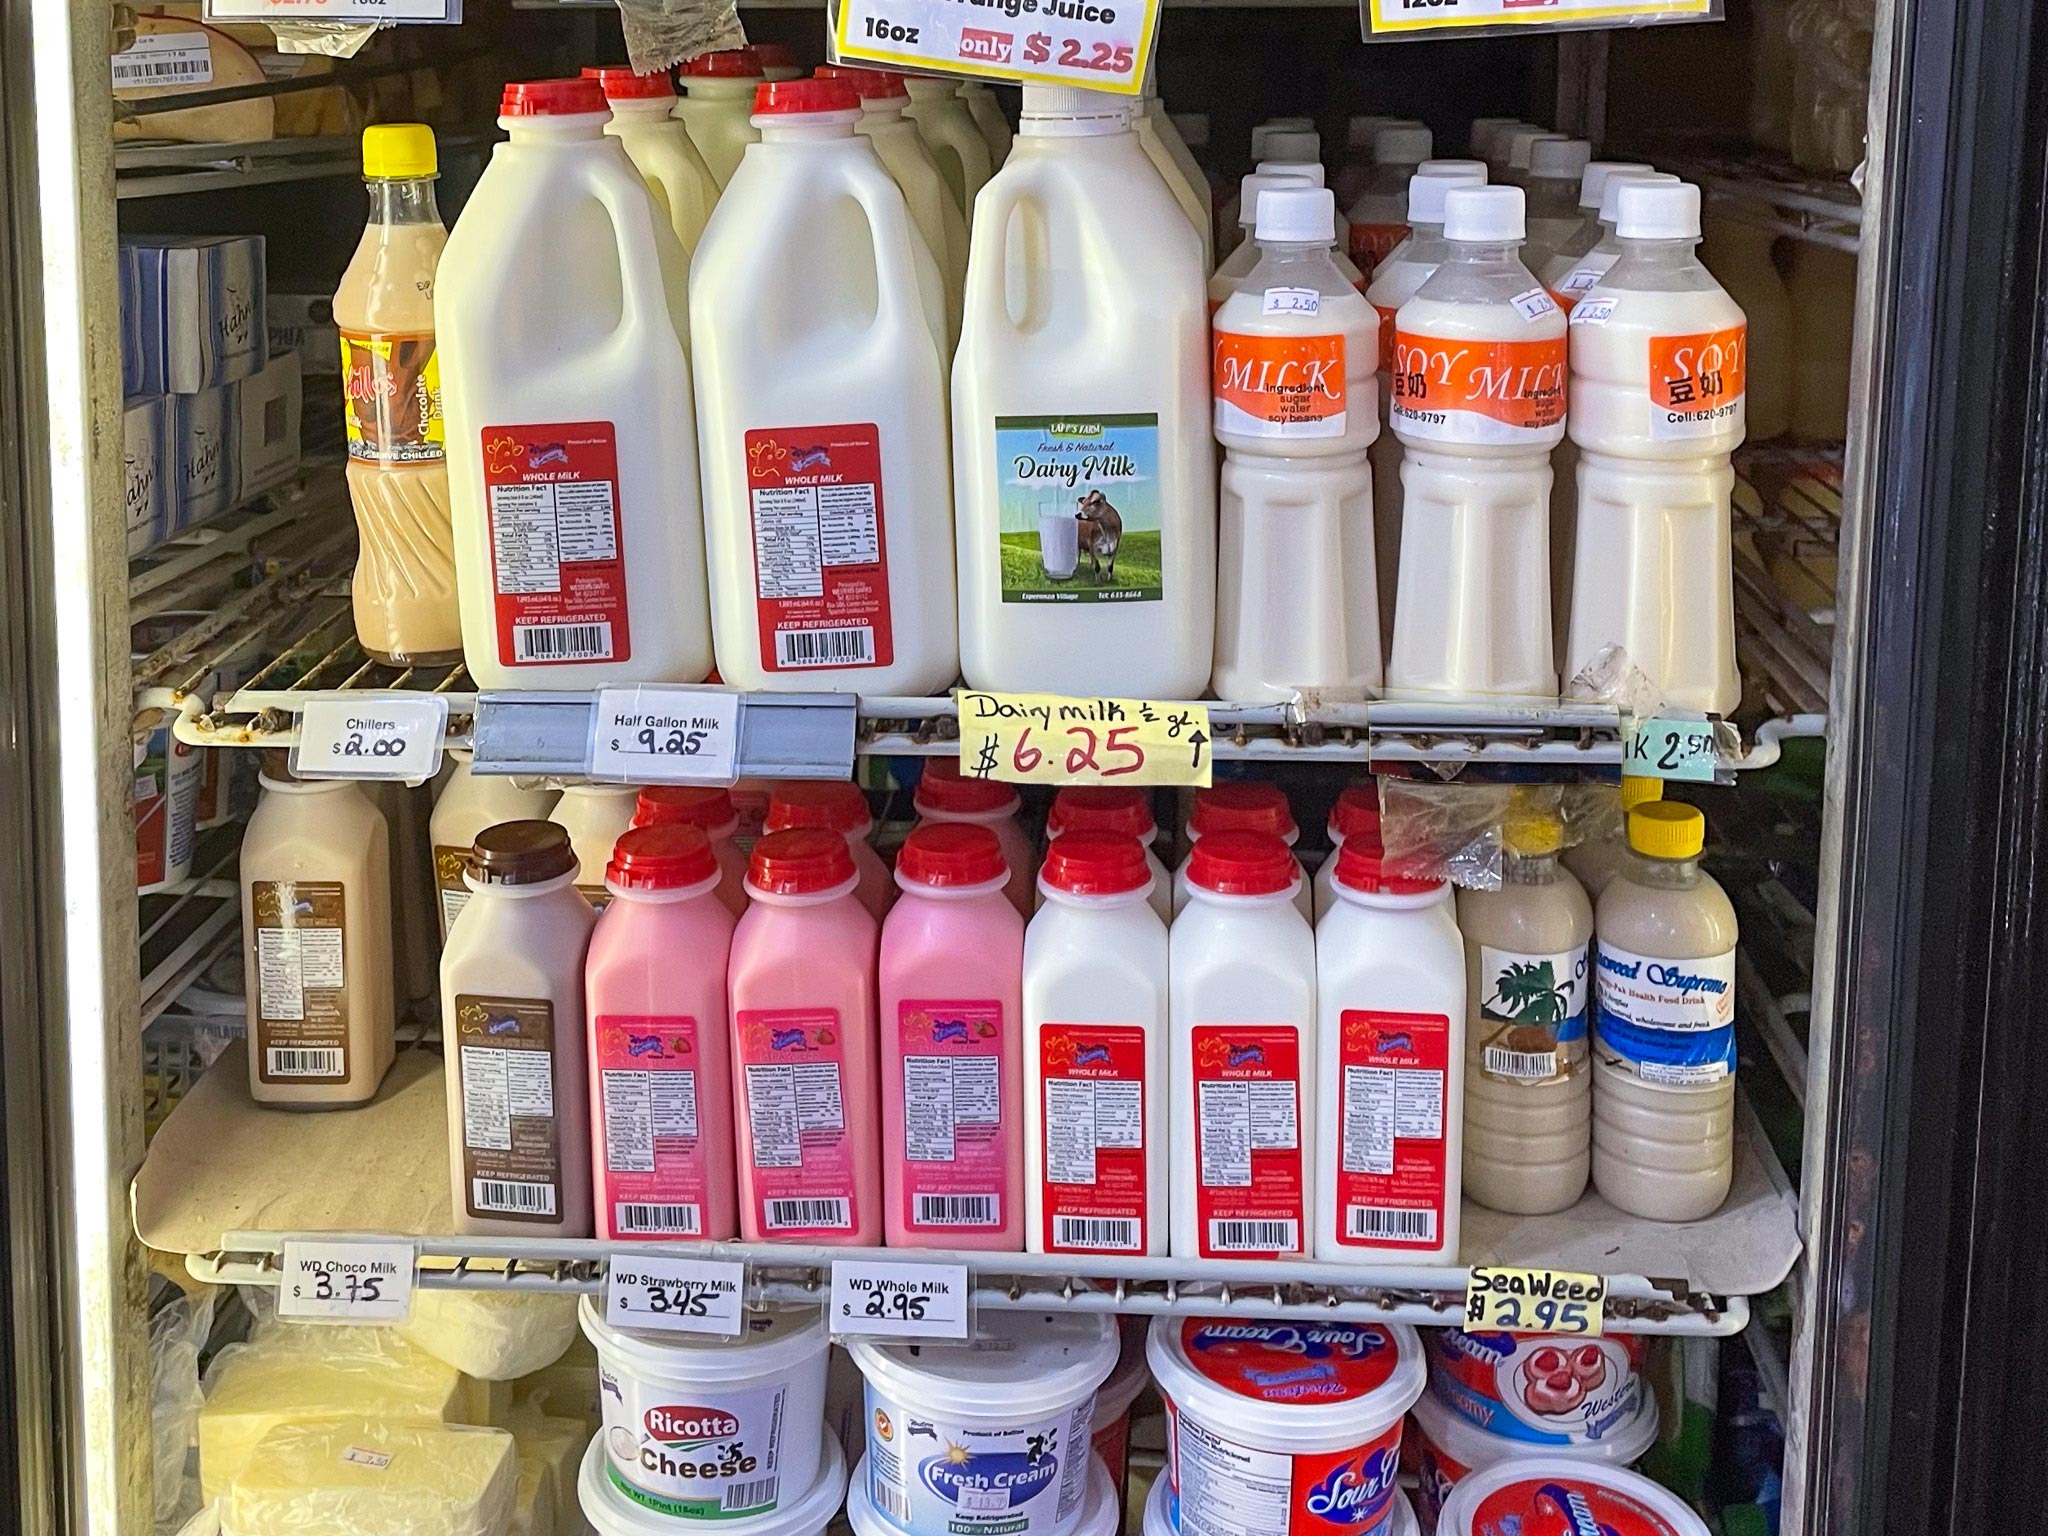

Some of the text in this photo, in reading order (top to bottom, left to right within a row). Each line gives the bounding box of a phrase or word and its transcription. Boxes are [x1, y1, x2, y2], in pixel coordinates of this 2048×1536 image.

[1042, 0, 1116, 24] Juice
[865, 17, 920, 44] 16oz
[960, 31, 1135, 73] only $ 2.25
[1273, 297, 1318, 312] $ 2.50
[1222, 357, 1341, 400] MILK
[1396, 344, 1566, 401] SOY MILK
[1395, 372, 1427, 398] 豆奶
[1666, 371, 1723, 405] 豆奶
[417, 374, 431, 436] Chocolate
[431, 385, 443, 421] Drink
[1279, 395, 1311, 405] sugar
[1280, 404, 1311, 413] water
[1268, 413, 1323, 424] soy beans
[1051, 423, 1101, 434] LAPP'S FARM
[1038, 441, 1115, 452] Fresh & Natural
[400, 450, 444, 460] CHILLED
[522, 472, 556, 482] WHOLE
[1014, 454, 1136, 487] Dairy Milk
[784, 476, 818, 485] WHOLE
[497, 485, 531, 493] Nutrition
[760, 489, 793, 497] Nutrition
[1056, 592, 1079, 600] Village
[515, 613, 607, 625] KEEP REFRIGERATED
[777, 618, 869, 630] KEEP REFRIGERATED
[964, 694, 1051, 731] Dairy
[1059, 700, 1126, 722] milk
[345, 717, 396, 731] Chillers
[614, 714, 720, 731] Half Gallon Milk
[332, 733, 407, 757] $ 2.00
[610, 728, 709, 756] $ 9.25
[970, 726, 1145, 779] $ 6.25
[1646, 963, 1728, 996] Supreme
[1628, 989, 1656, 1001] Health
[1658, 995, 1680, 1005] Food
[1681, 995, 1706, 1005] Drink
[1677, 1021, 1692, 1029] and
[1692, 1020, 1710, 1029] fresh
[289, 1039, 340, 1047] REFRIGERATED
[463, 1048, 491, 1056] Nutrition
[1368, 1056, 1398, 1064] WHOLE
[1068, 1068, 1098, 1076] WHOLE
[1347, 1068, 1378, 1076] Nutrition
[476, 1170, 550, 1182] KEEP REFRIGERATED
[788, 1188, 845, 1196] REFRIGERATED
[1351, 1196, 1433, 1207] KEEP REFRIGERATED
[1079, 1207, 1137, 1216] REFRIGERATED
[1213, 1209, 1293, 1218] KEEP REFRIGERATED
[300, 1260, 397, 1275] WD Choco Milk
[292, 1272, 384, 1302] $ 3.75
[615, 1272, 736, 1293] WD Strawberry Milk
[850, 1279, 949, 1294] WD Whole Milk
[620, 1287, 720, 1316] $ 3.45
[842, 1291, 931, 1320] $ 2.95
[1468, 1294, 1589, 1332] $ 2.95
[1203, 1324, 1386, 1355] Sour Cream
[649, 1409, 738, 1437] Ricotta
[639, 1448, 757, 1480] Cheese
[932, 1465, 989, 1489] Fresh
[993, 1463, 1055, 1489] Cream
[1307, 1471, 1379, 1515] Sour
[955, 1511, 1024, 1521] Keep Refrigerated
[983, 1521, 1025, 1534] Natural
